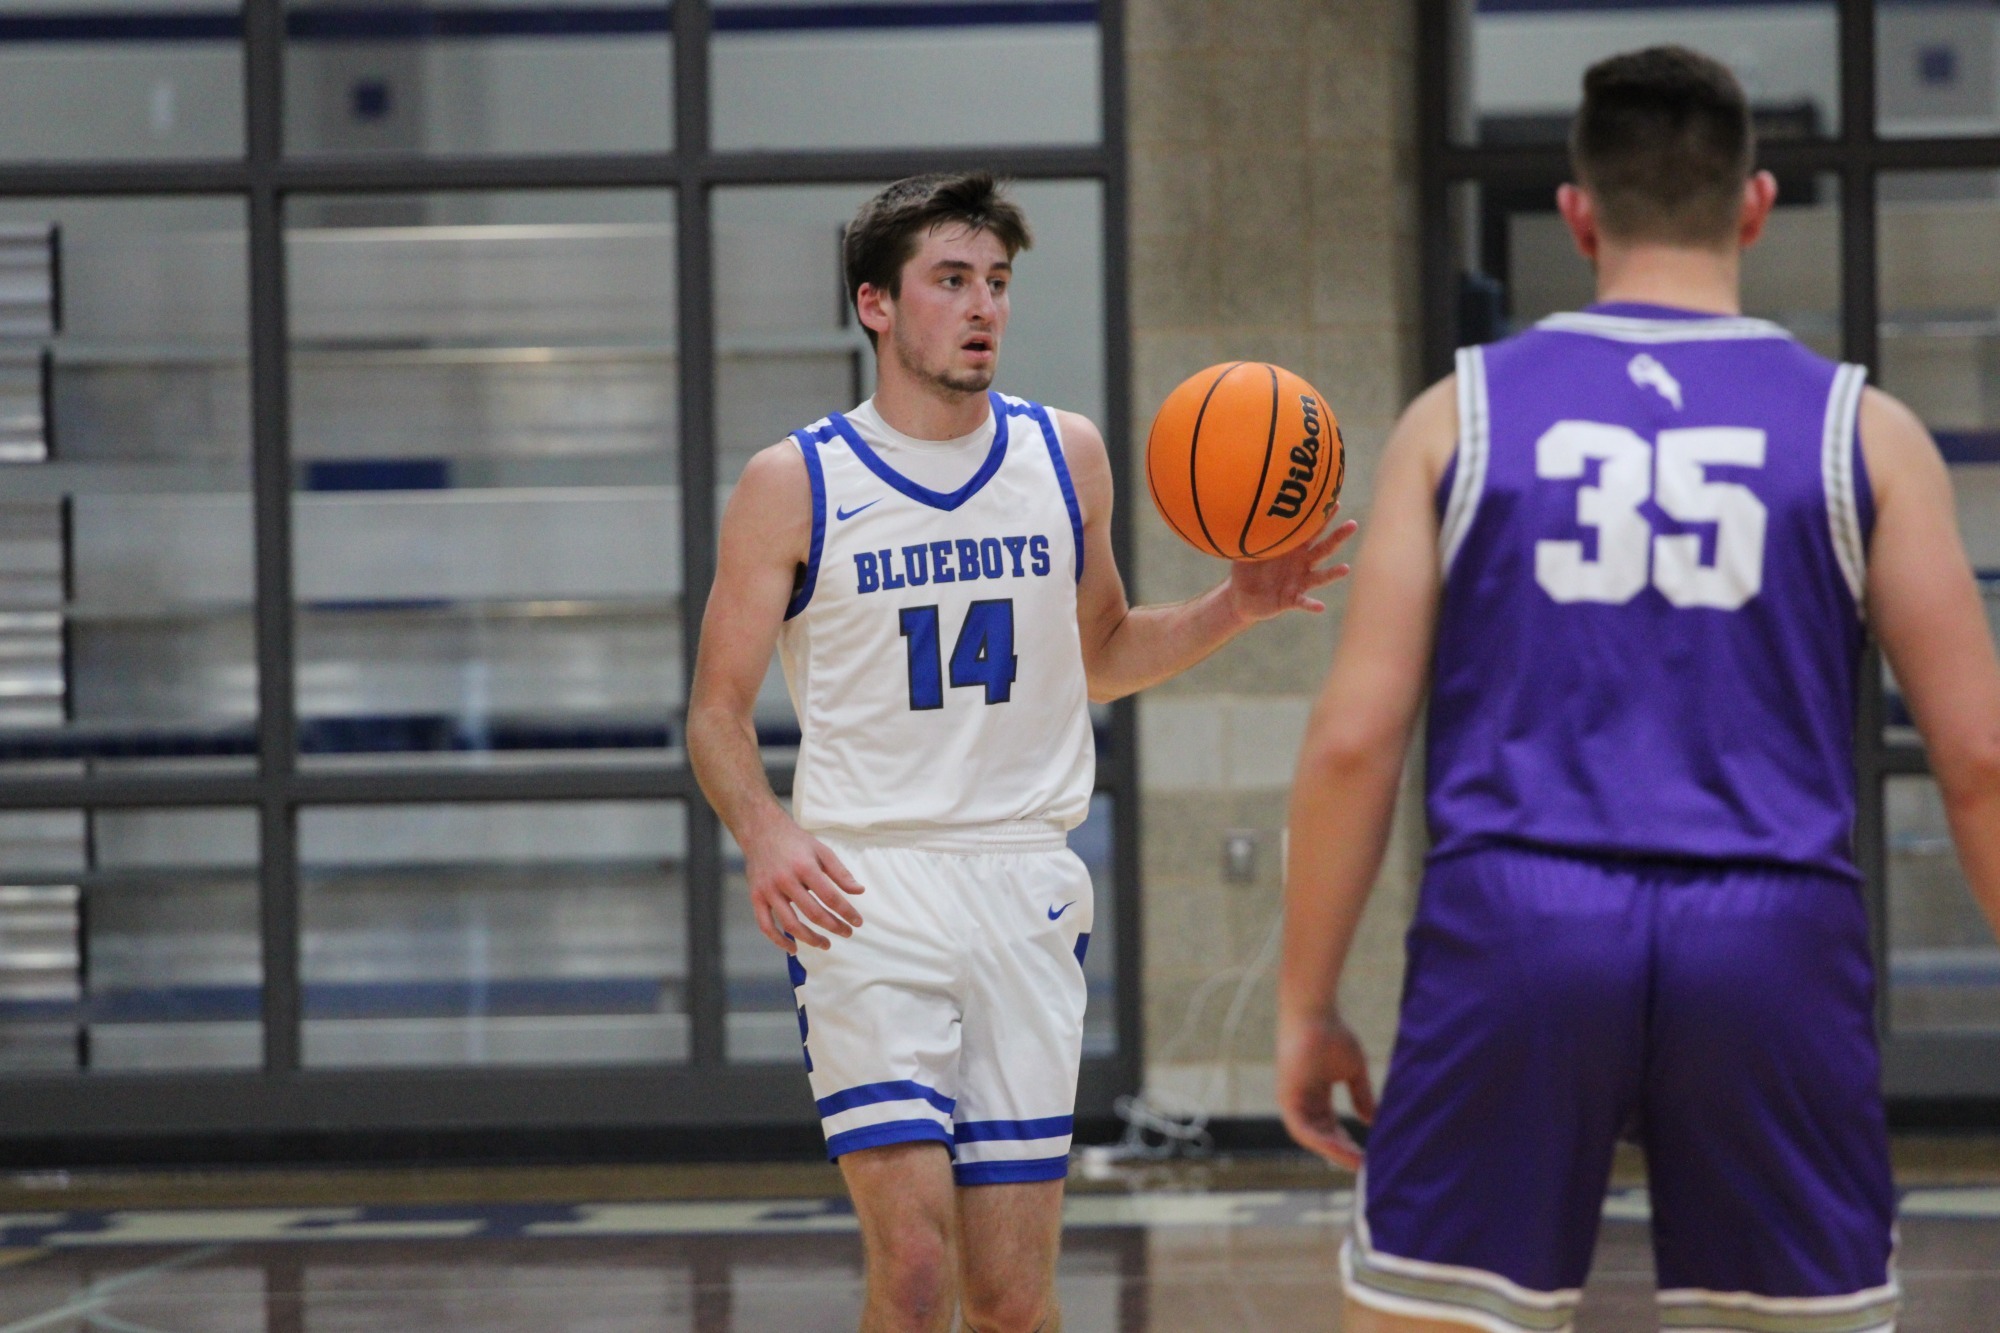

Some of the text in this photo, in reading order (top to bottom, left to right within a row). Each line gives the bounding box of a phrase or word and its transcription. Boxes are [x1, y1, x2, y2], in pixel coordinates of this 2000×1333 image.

[1266, 393, 1320, 519] Wilson
[1535, 419, 1768, 612] 35
[853, 534, 1051, 595] BLUEBOYS
[898, 598, 1018, 711] 14
